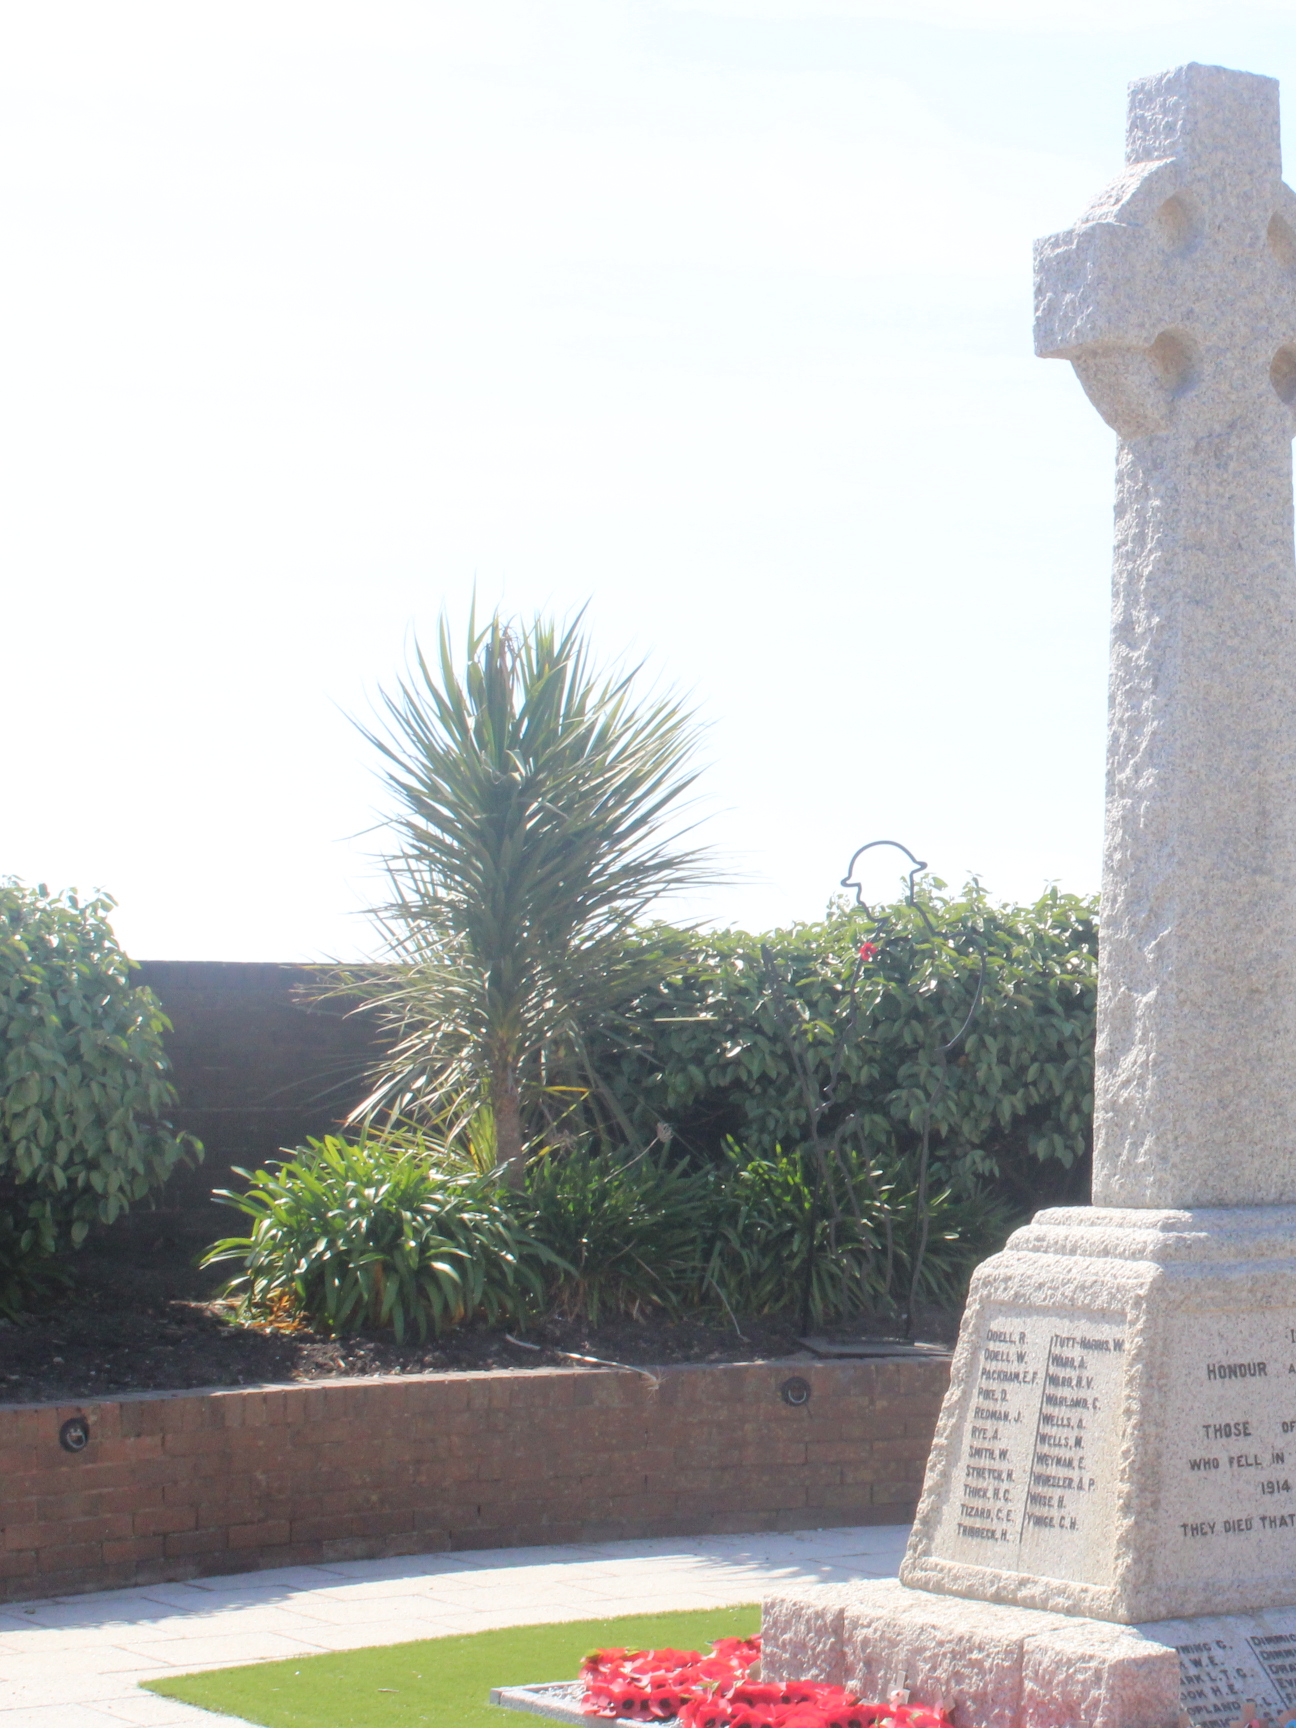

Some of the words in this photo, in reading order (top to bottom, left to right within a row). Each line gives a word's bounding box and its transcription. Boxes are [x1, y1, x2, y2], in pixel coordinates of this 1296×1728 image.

[1207, 1361, 1267, 1381] HONOUR
[1202, 1421, 1252, 1440] THOSE
[1281, 1420, 1296, 1434] OF
[1189, 1458, 1220, 1472] WHO
[1228, 1454, 1263, 1469] FELL
[1272, 1452, 1285, 1465] IN
[1261, 1480, 1291, 1495] 1914
[1181, 1522, 1216, 1538] THEY
[1224, 1519, 1253, 1534] DIED
[1260, 1513, 1295, 1530] THAT
